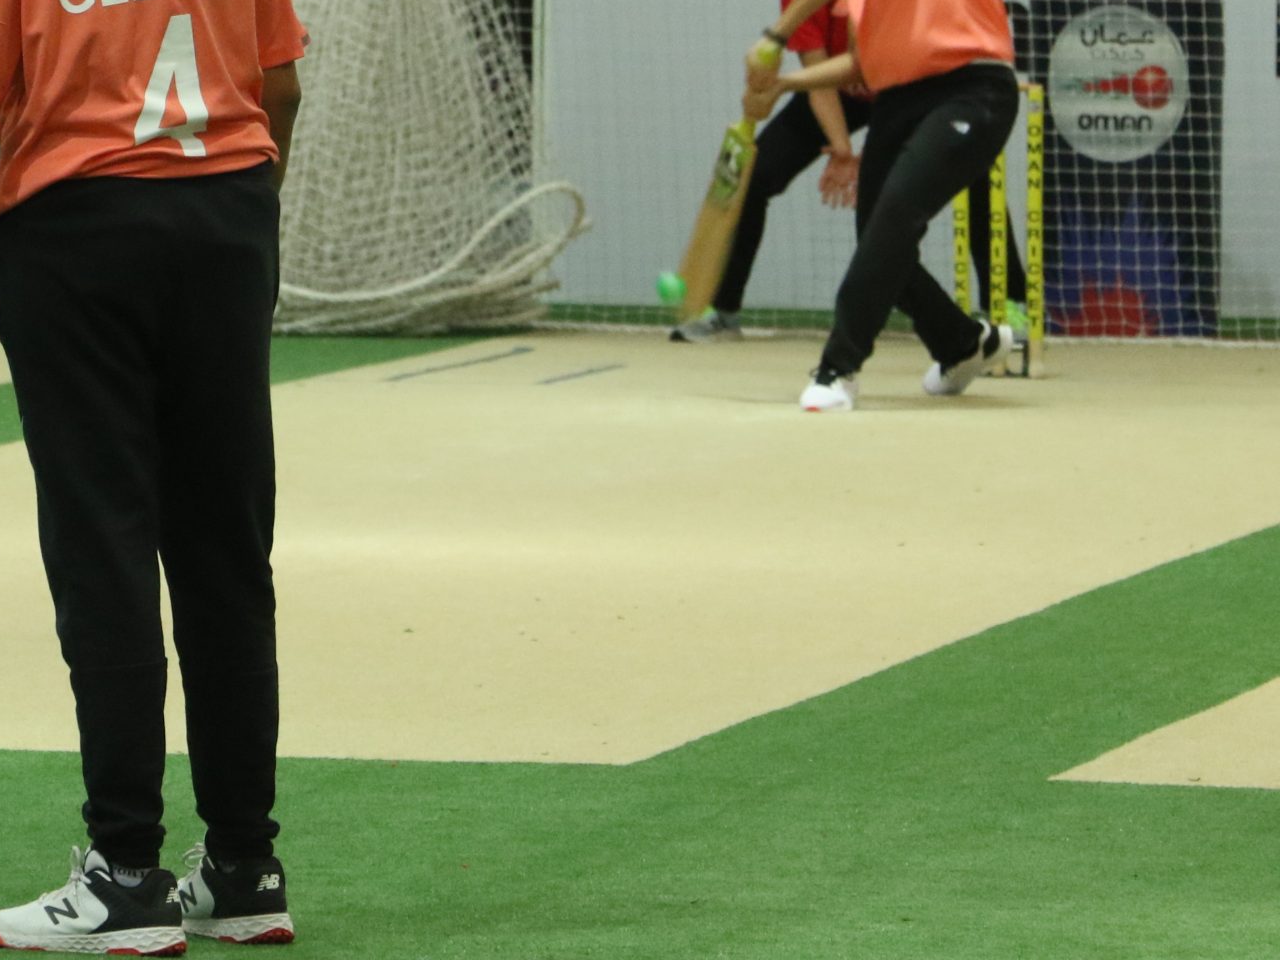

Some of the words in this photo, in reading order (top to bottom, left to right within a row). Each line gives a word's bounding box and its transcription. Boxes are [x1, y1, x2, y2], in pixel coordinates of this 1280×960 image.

[134, 13, 209, 157] 4
[1078, 114, 1153, 132] oman
[1028, 125, 1042, 188] OMAN
[1027, 211, 1042, 326] CRICKET
